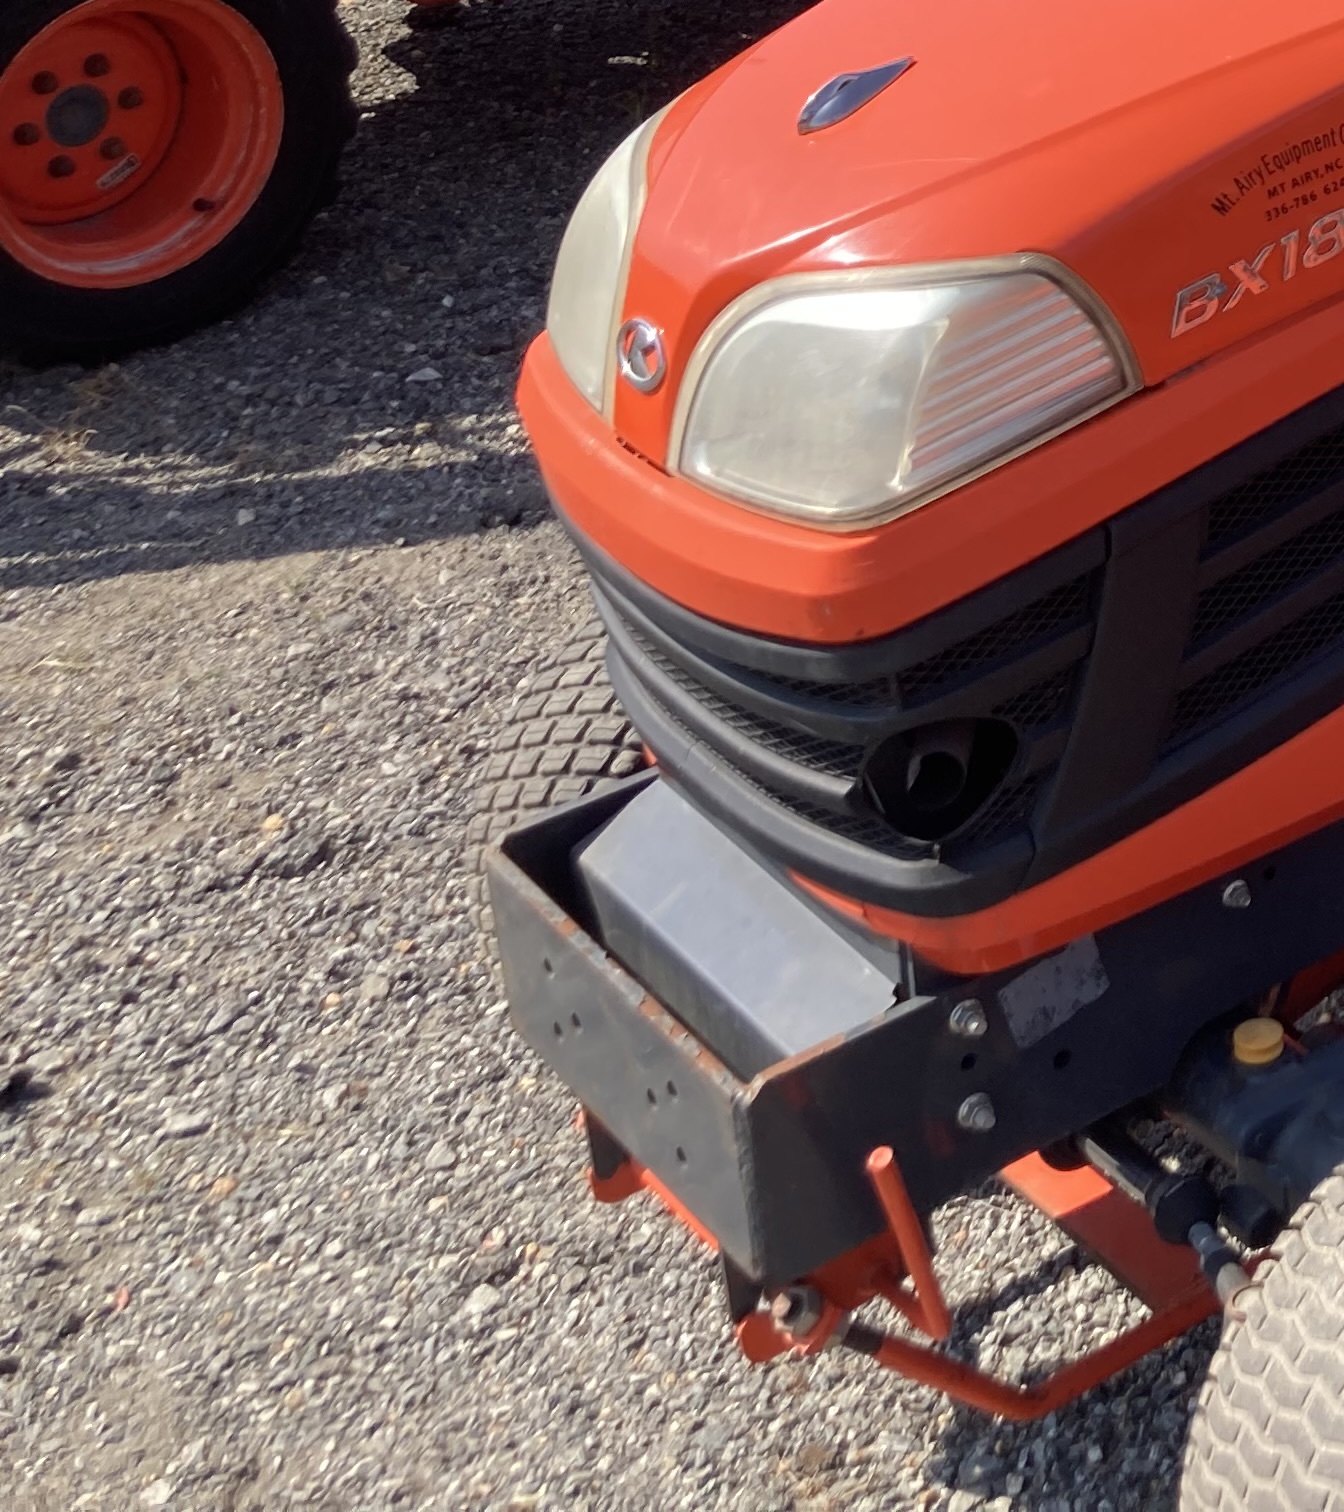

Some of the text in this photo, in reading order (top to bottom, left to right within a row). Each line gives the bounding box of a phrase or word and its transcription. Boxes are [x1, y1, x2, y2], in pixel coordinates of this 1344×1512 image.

[1211, 192, 1241, 217] Mt.
[1233, 164, 1266, 198] Airy
[1260, 130, 1338, 175] Equipment
[1267, 179, 1286, 200] MT
[1265, 190, 1318, 222] 336-786
